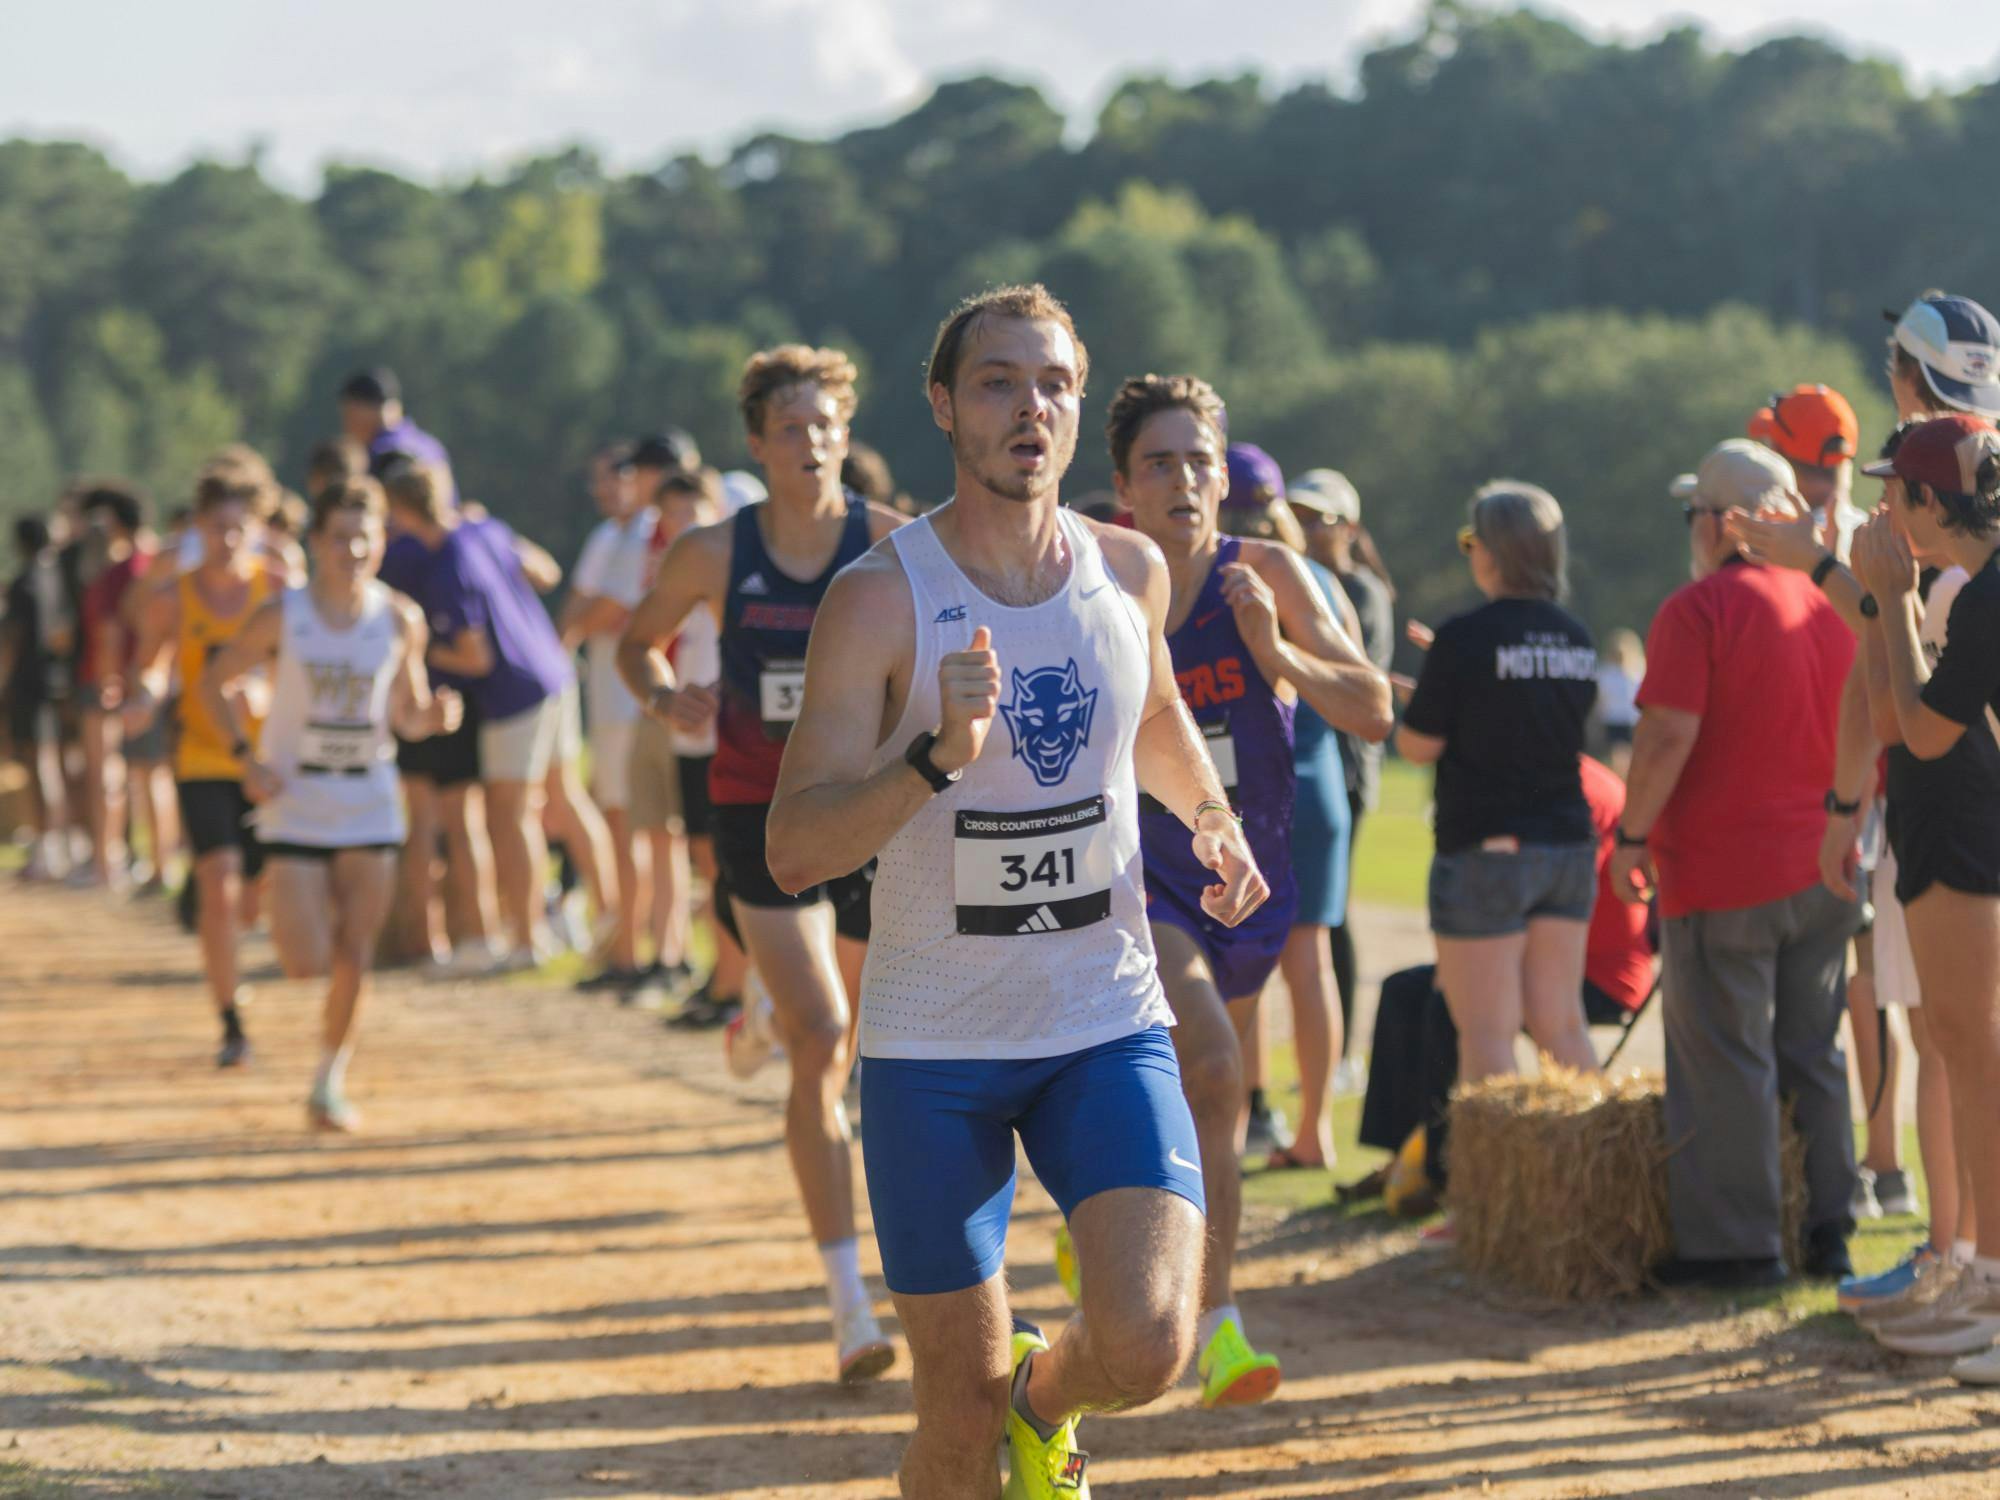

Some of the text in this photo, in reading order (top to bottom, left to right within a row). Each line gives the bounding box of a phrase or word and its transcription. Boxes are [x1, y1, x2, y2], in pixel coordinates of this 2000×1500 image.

[934, 605, 968, 622] ACC
[964, 806, 1099, 831] CROSS COUNTRY CHALLENGE
[1000, 848, 1075, 892] 341
